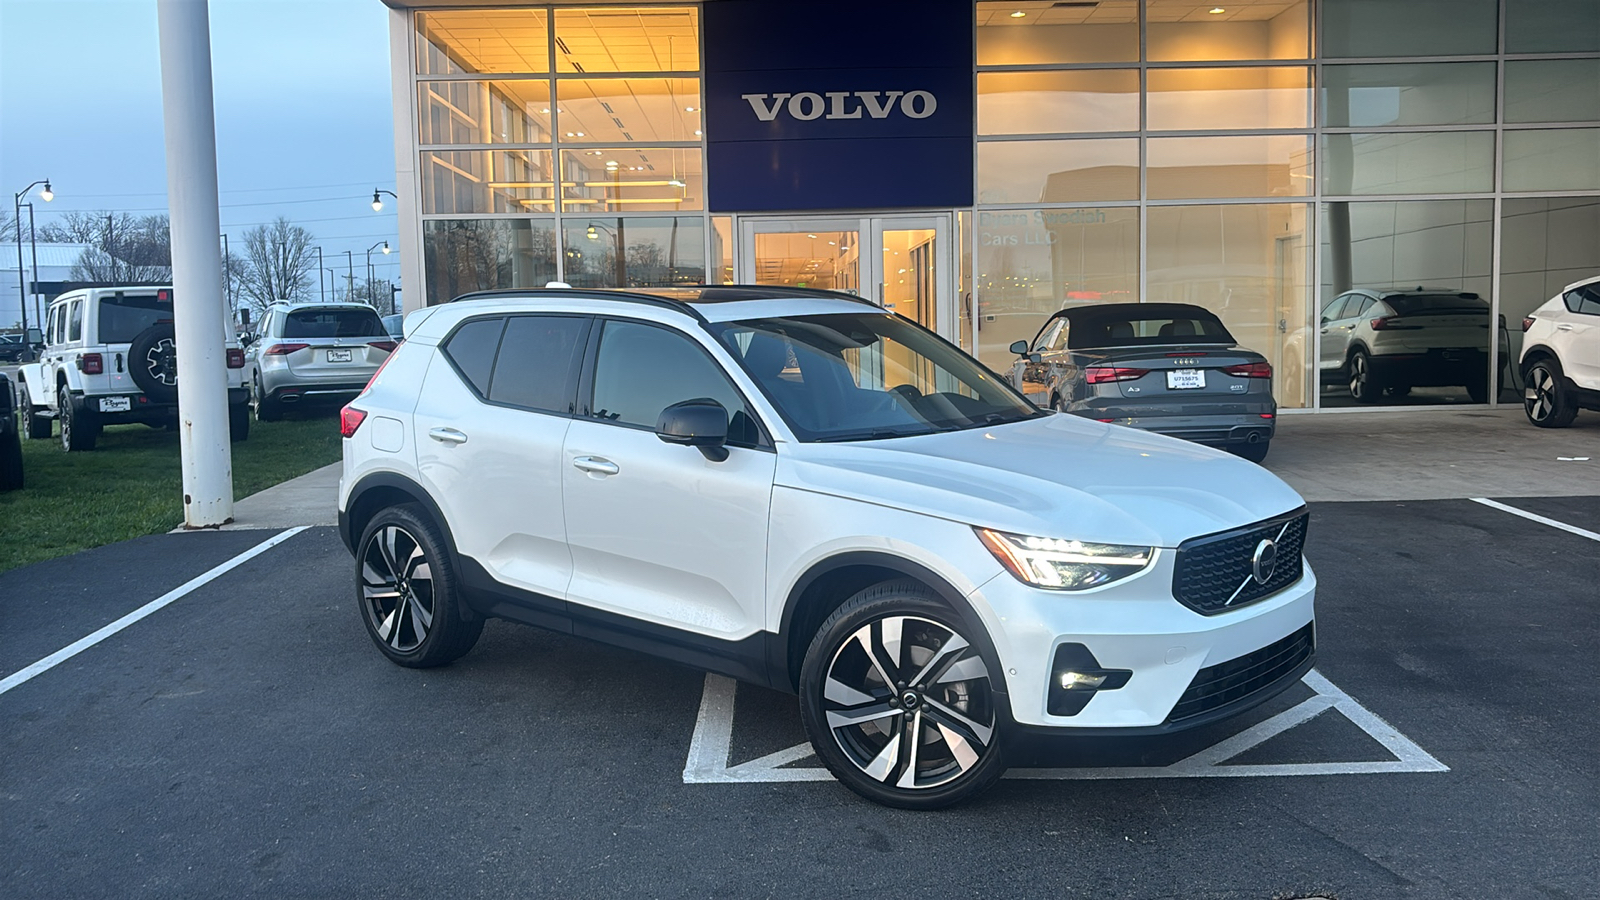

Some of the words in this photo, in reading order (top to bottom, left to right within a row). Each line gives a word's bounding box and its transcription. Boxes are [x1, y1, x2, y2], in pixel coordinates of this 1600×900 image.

[741, 90, 937, 121] VOLVO
[1033, 209, 1106, 225] Swedish
[980, 232, 1018, 246] Cars
[1025, 230, 1057, 245] LLC
